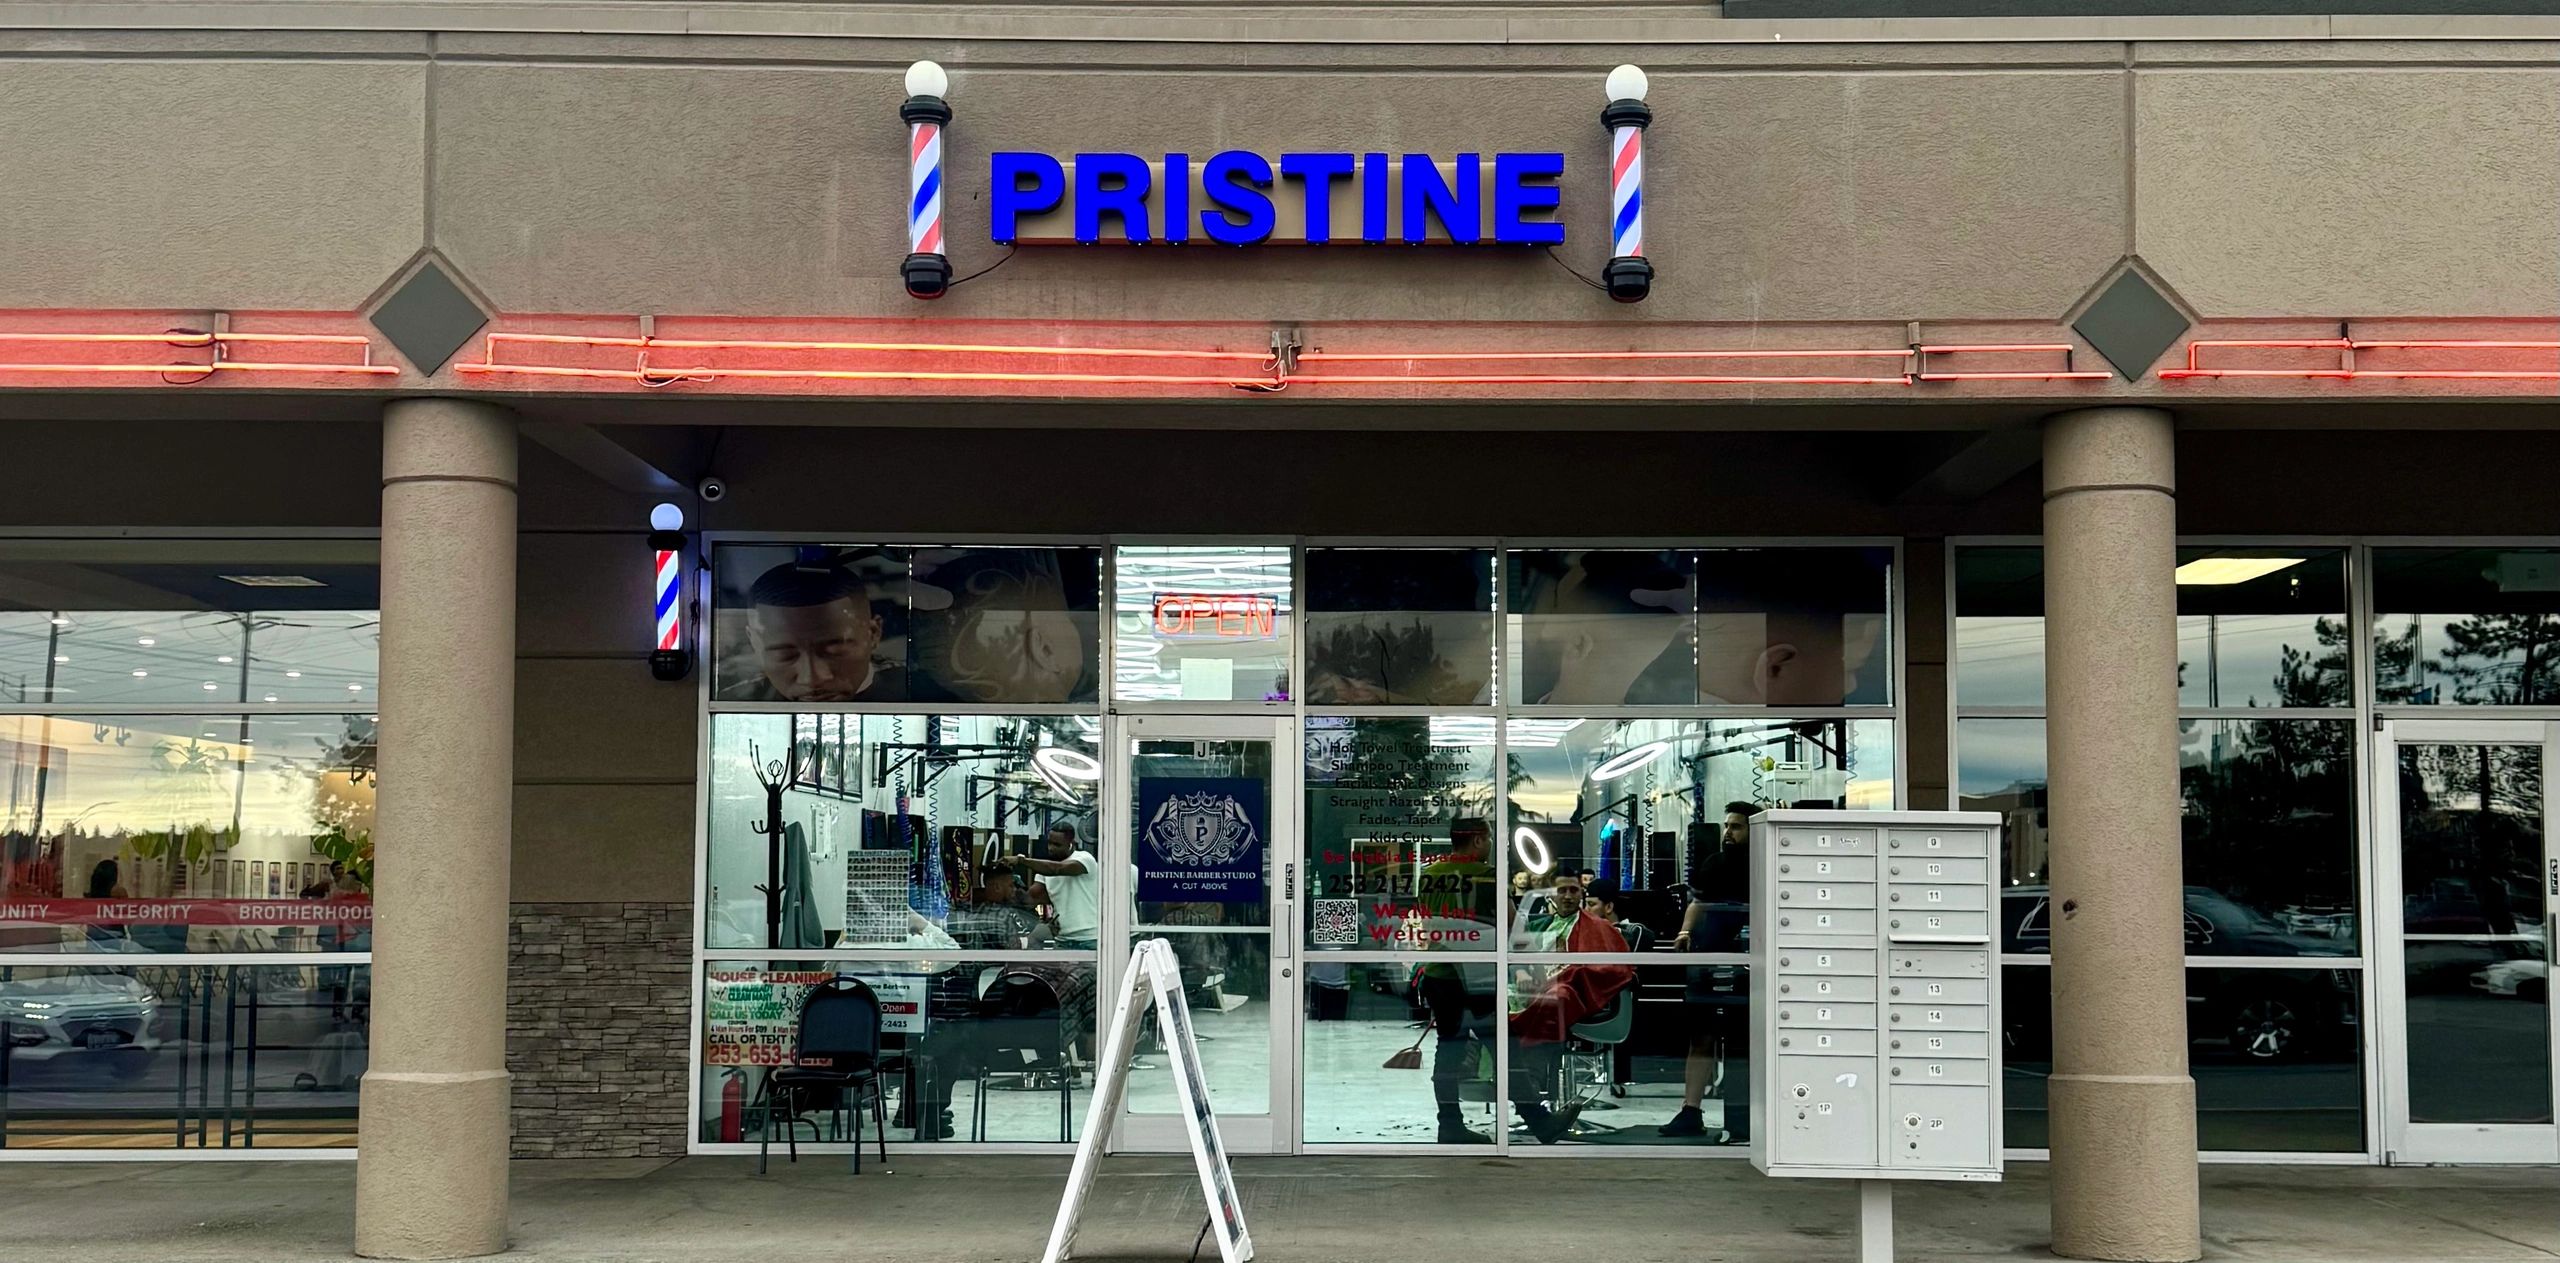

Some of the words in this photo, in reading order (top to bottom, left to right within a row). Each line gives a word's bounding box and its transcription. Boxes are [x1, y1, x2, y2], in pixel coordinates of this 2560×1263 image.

[991, 151, 1565, 246] PRISTINE
[1156, 596, 1274, 636] OPEN
[1197, 742, 1206, 758] J
[1330, 742, 1353, 753] Hot
[1360, 742, 1397, 753] Towel
[1403, 742, 1471, 754] Treatment
[1331, 760, 1394, 775] Shampoo
[1400, 760, 1470, 772] Treatment
[1418, 778, 1466, 791] Designs
[1330, 796, 1385, 810] Straight
[1389, 796, 1426, 808] Razor
[1431, 796, 1472, 808] Shave
[1359, 814, 1400, 826] Fades,
[1405, 814, 1442, 827] Taper
[1369, 831, 1399, 843] Kids
[1402, 831, 1433, 843] Cuts
[1820, 863, 1827, 871] 2
[1929, 865, 1940, 873] 10
[1145, 871, 1186, 880] PRISTINE
[1187, 871, 1222, 880] BARBER
[1222, 871, 1256, 880] STUDIO
[1172, 882, 1179, 890] A
[1182, 882, 1198, 890] CUT
[1201, 882, 1228, 890] ABOVE
[1328, 874, 1367, 894] 253
[1375, 874, 1414, 894] 217
[1422, 874, 1474, 894] 2425
[1820, 889, 1827, 898] 3
[1929, 891, 1939, 900] 11
[97, 904, 192, 920] INTEGRITY
[239, 904, 373, 920] BROTHERHOOD
[1373, 902, 1433, 920] Walk
[1820, 916, 1827, 925] 4
[1929, 918, 1940, 927] 12
[1369, 924, 1481, 943] Welcome
[1820, 957, 1827, 965] 5
[709, 972, 757, 984] HOUSE
[1820, 983, 1827, 991] 6
[1930, 985, 1940, 993] 13
[880, 1004, 906, 1014] Open
[1820, 1009, 1827, 1017] 7
[709, 1011, 732, 1020] CALL
[735, 1011, 749, 1020] US
[750, 1010, 783, 1020] TODAY
[1930, 1012, 1941, 1020] 14
[709, 1034, 737, 1044] CALL
[740, 1034, 757, 1044] OR
[762, 1034, 787, 1044] TEXT
[1930, 1039, 1941, 1047] 15
[1930, 1065, 1941, 1074] 16
[1819, 1104, 1831, 1112] 1P
[1930, 1120, 1942, 1128] 2P
